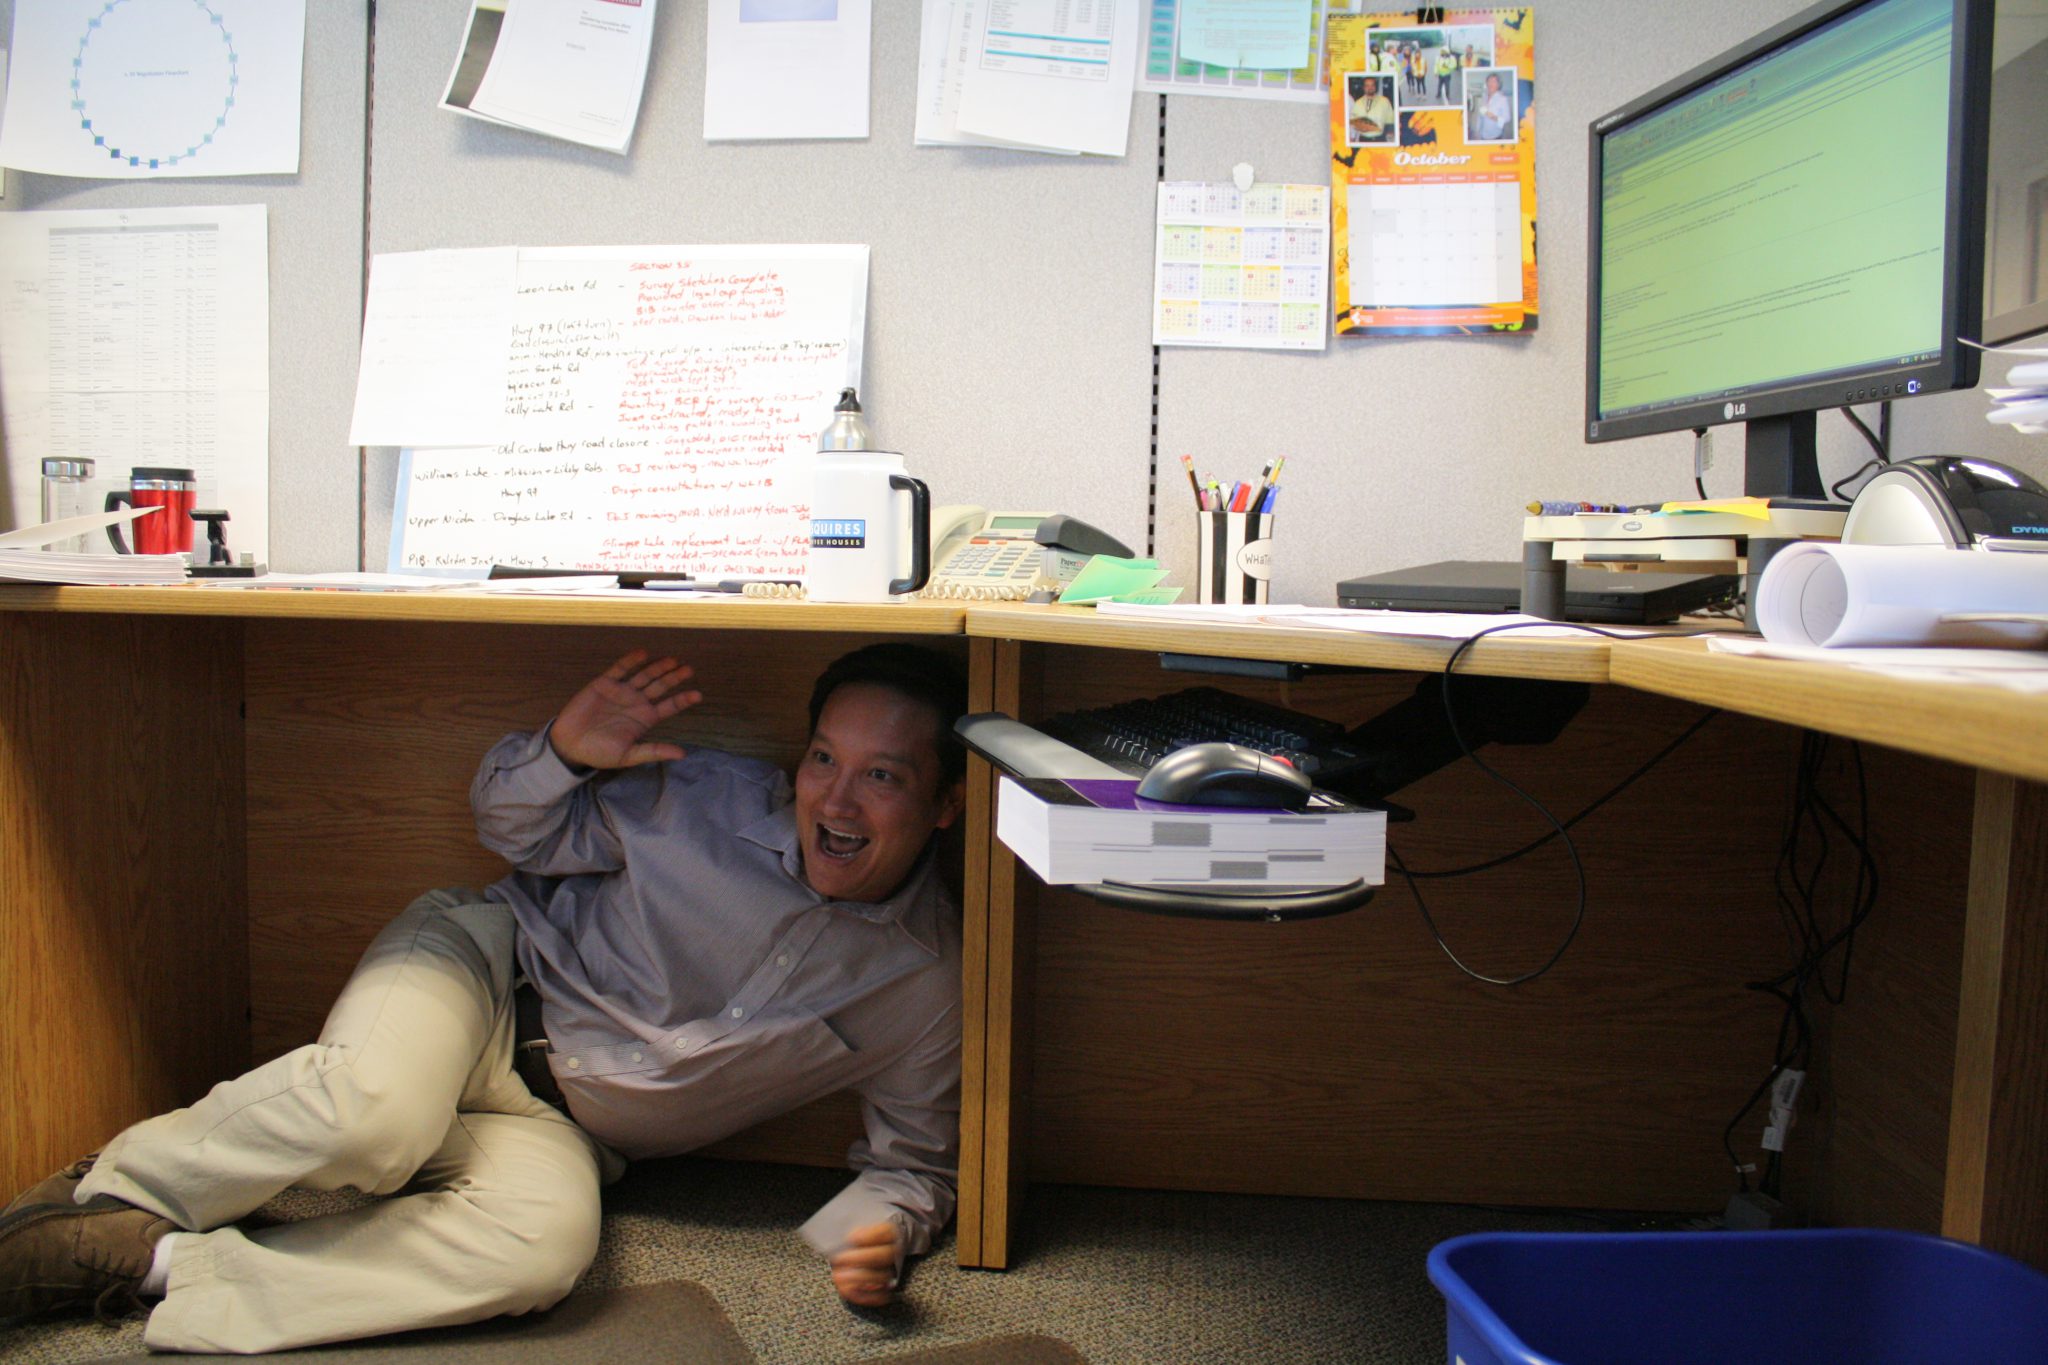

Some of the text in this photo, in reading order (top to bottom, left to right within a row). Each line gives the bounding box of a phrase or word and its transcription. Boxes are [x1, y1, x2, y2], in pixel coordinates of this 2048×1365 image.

[1394, 152, 1472, 166] October
[1735, 403, 1746, 416] LG
[2011, 526, 2048, 534] DYM
[826, 538, 861, 546] HOUSES
